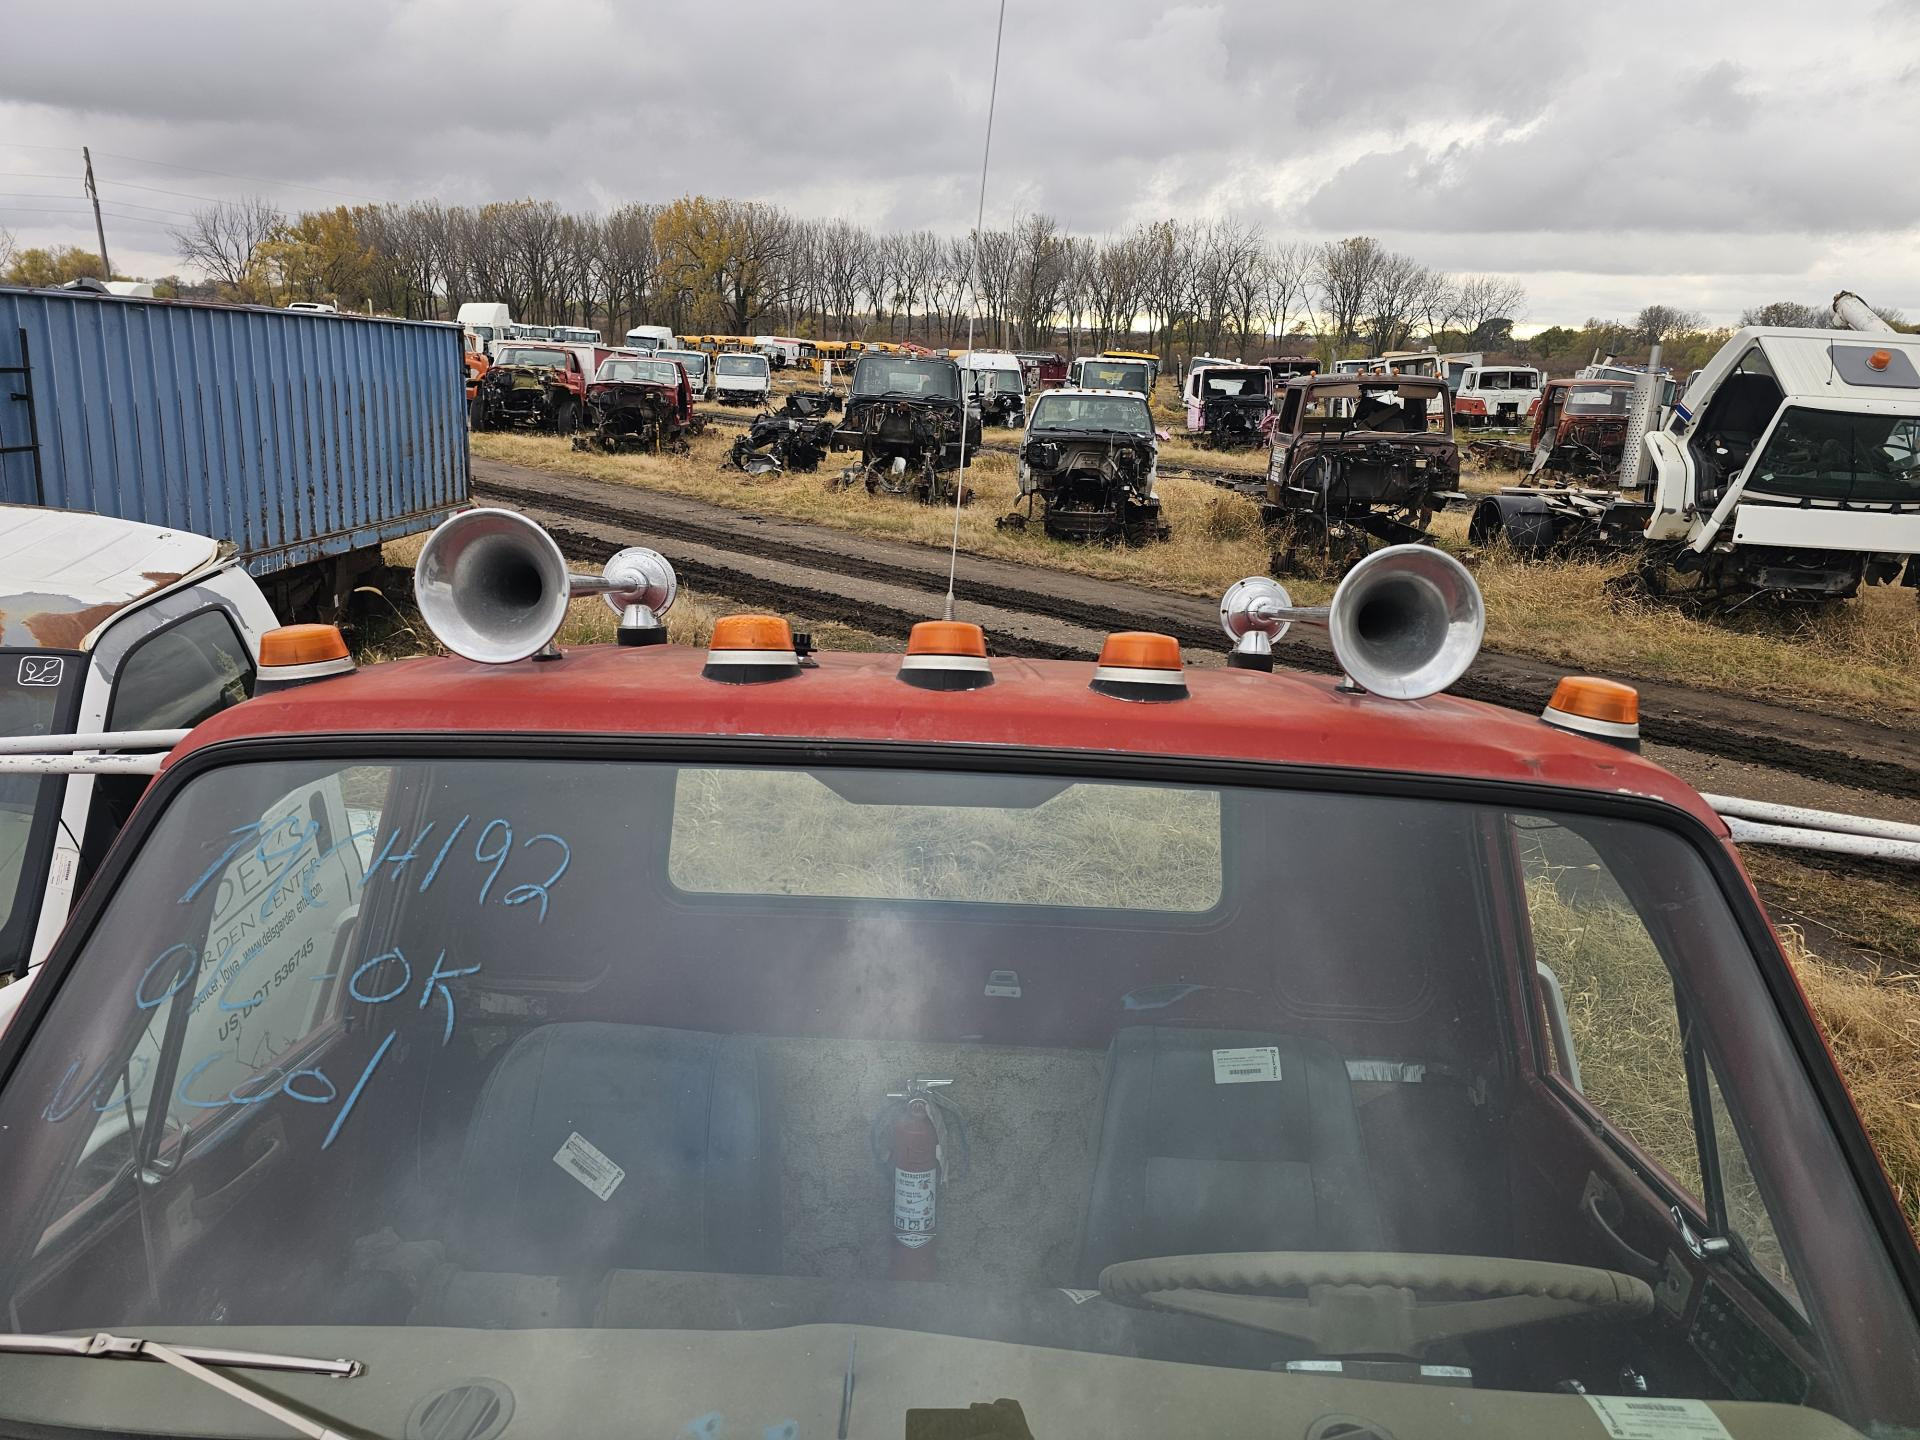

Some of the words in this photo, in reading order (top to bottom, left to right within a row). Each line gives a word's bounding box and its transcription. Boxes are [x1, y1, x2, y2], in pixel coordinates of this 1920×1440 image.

[218, 1013, 240, 1042] US
[243, 980, 271, 1019] DOT
[274, 937, 315, 988] 536745
[219, 959, 240, 984] Iowa
